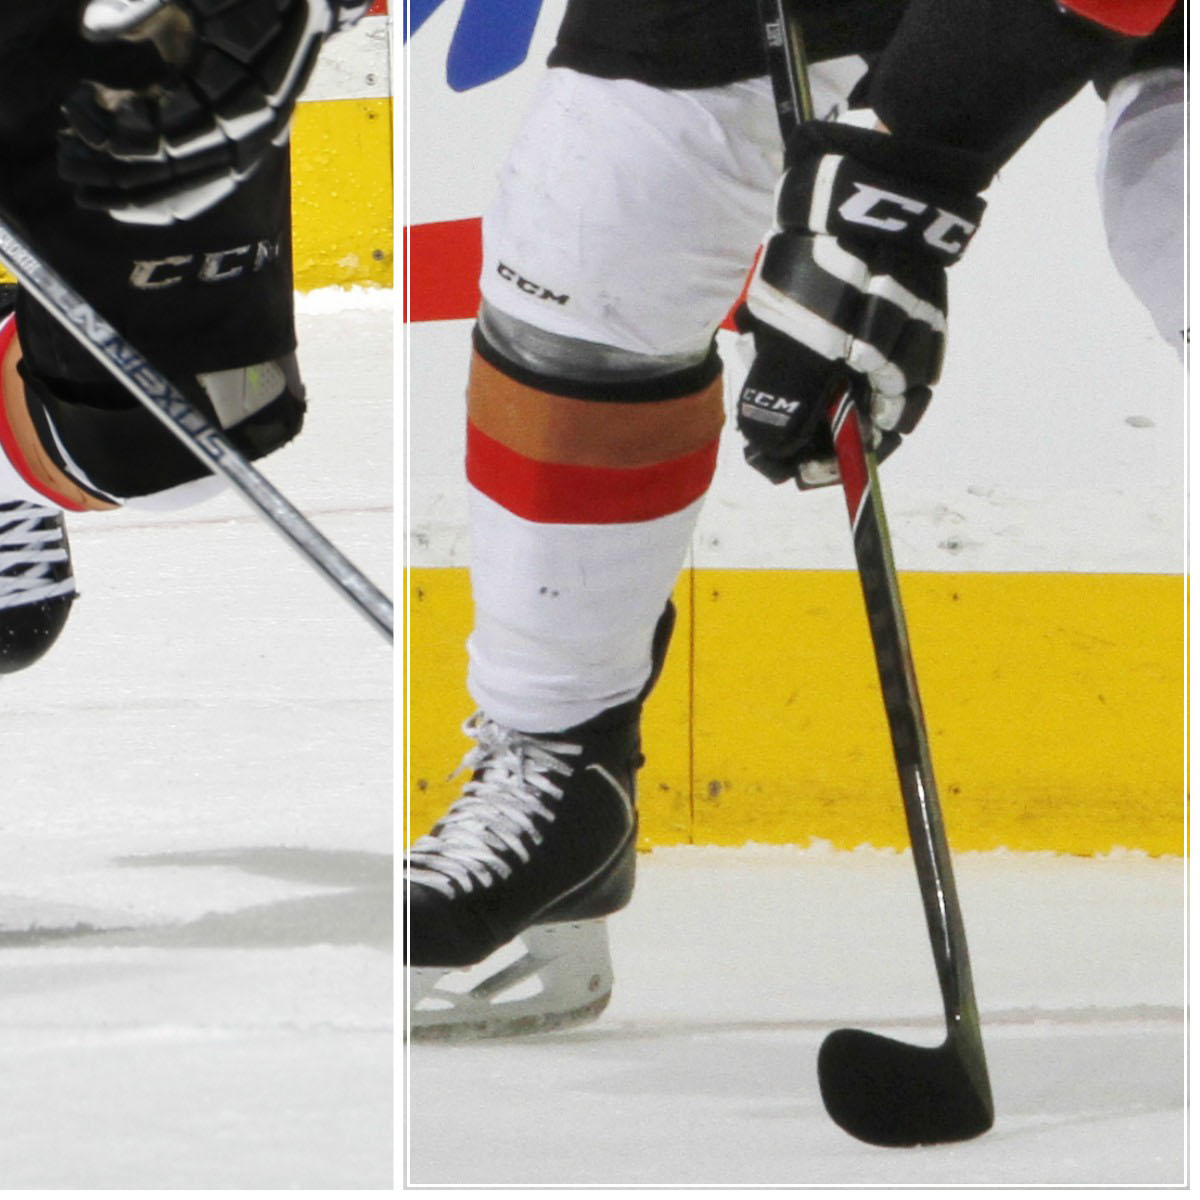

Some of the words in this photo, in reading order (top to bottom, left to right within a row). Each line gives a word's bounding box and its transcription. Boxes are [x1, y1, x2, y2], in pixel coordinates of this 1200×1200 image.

[497, 261, 570, 305] CCM
[103, 333, 227, 464] NEXUS
[743, 387, 800, 413] CCM
